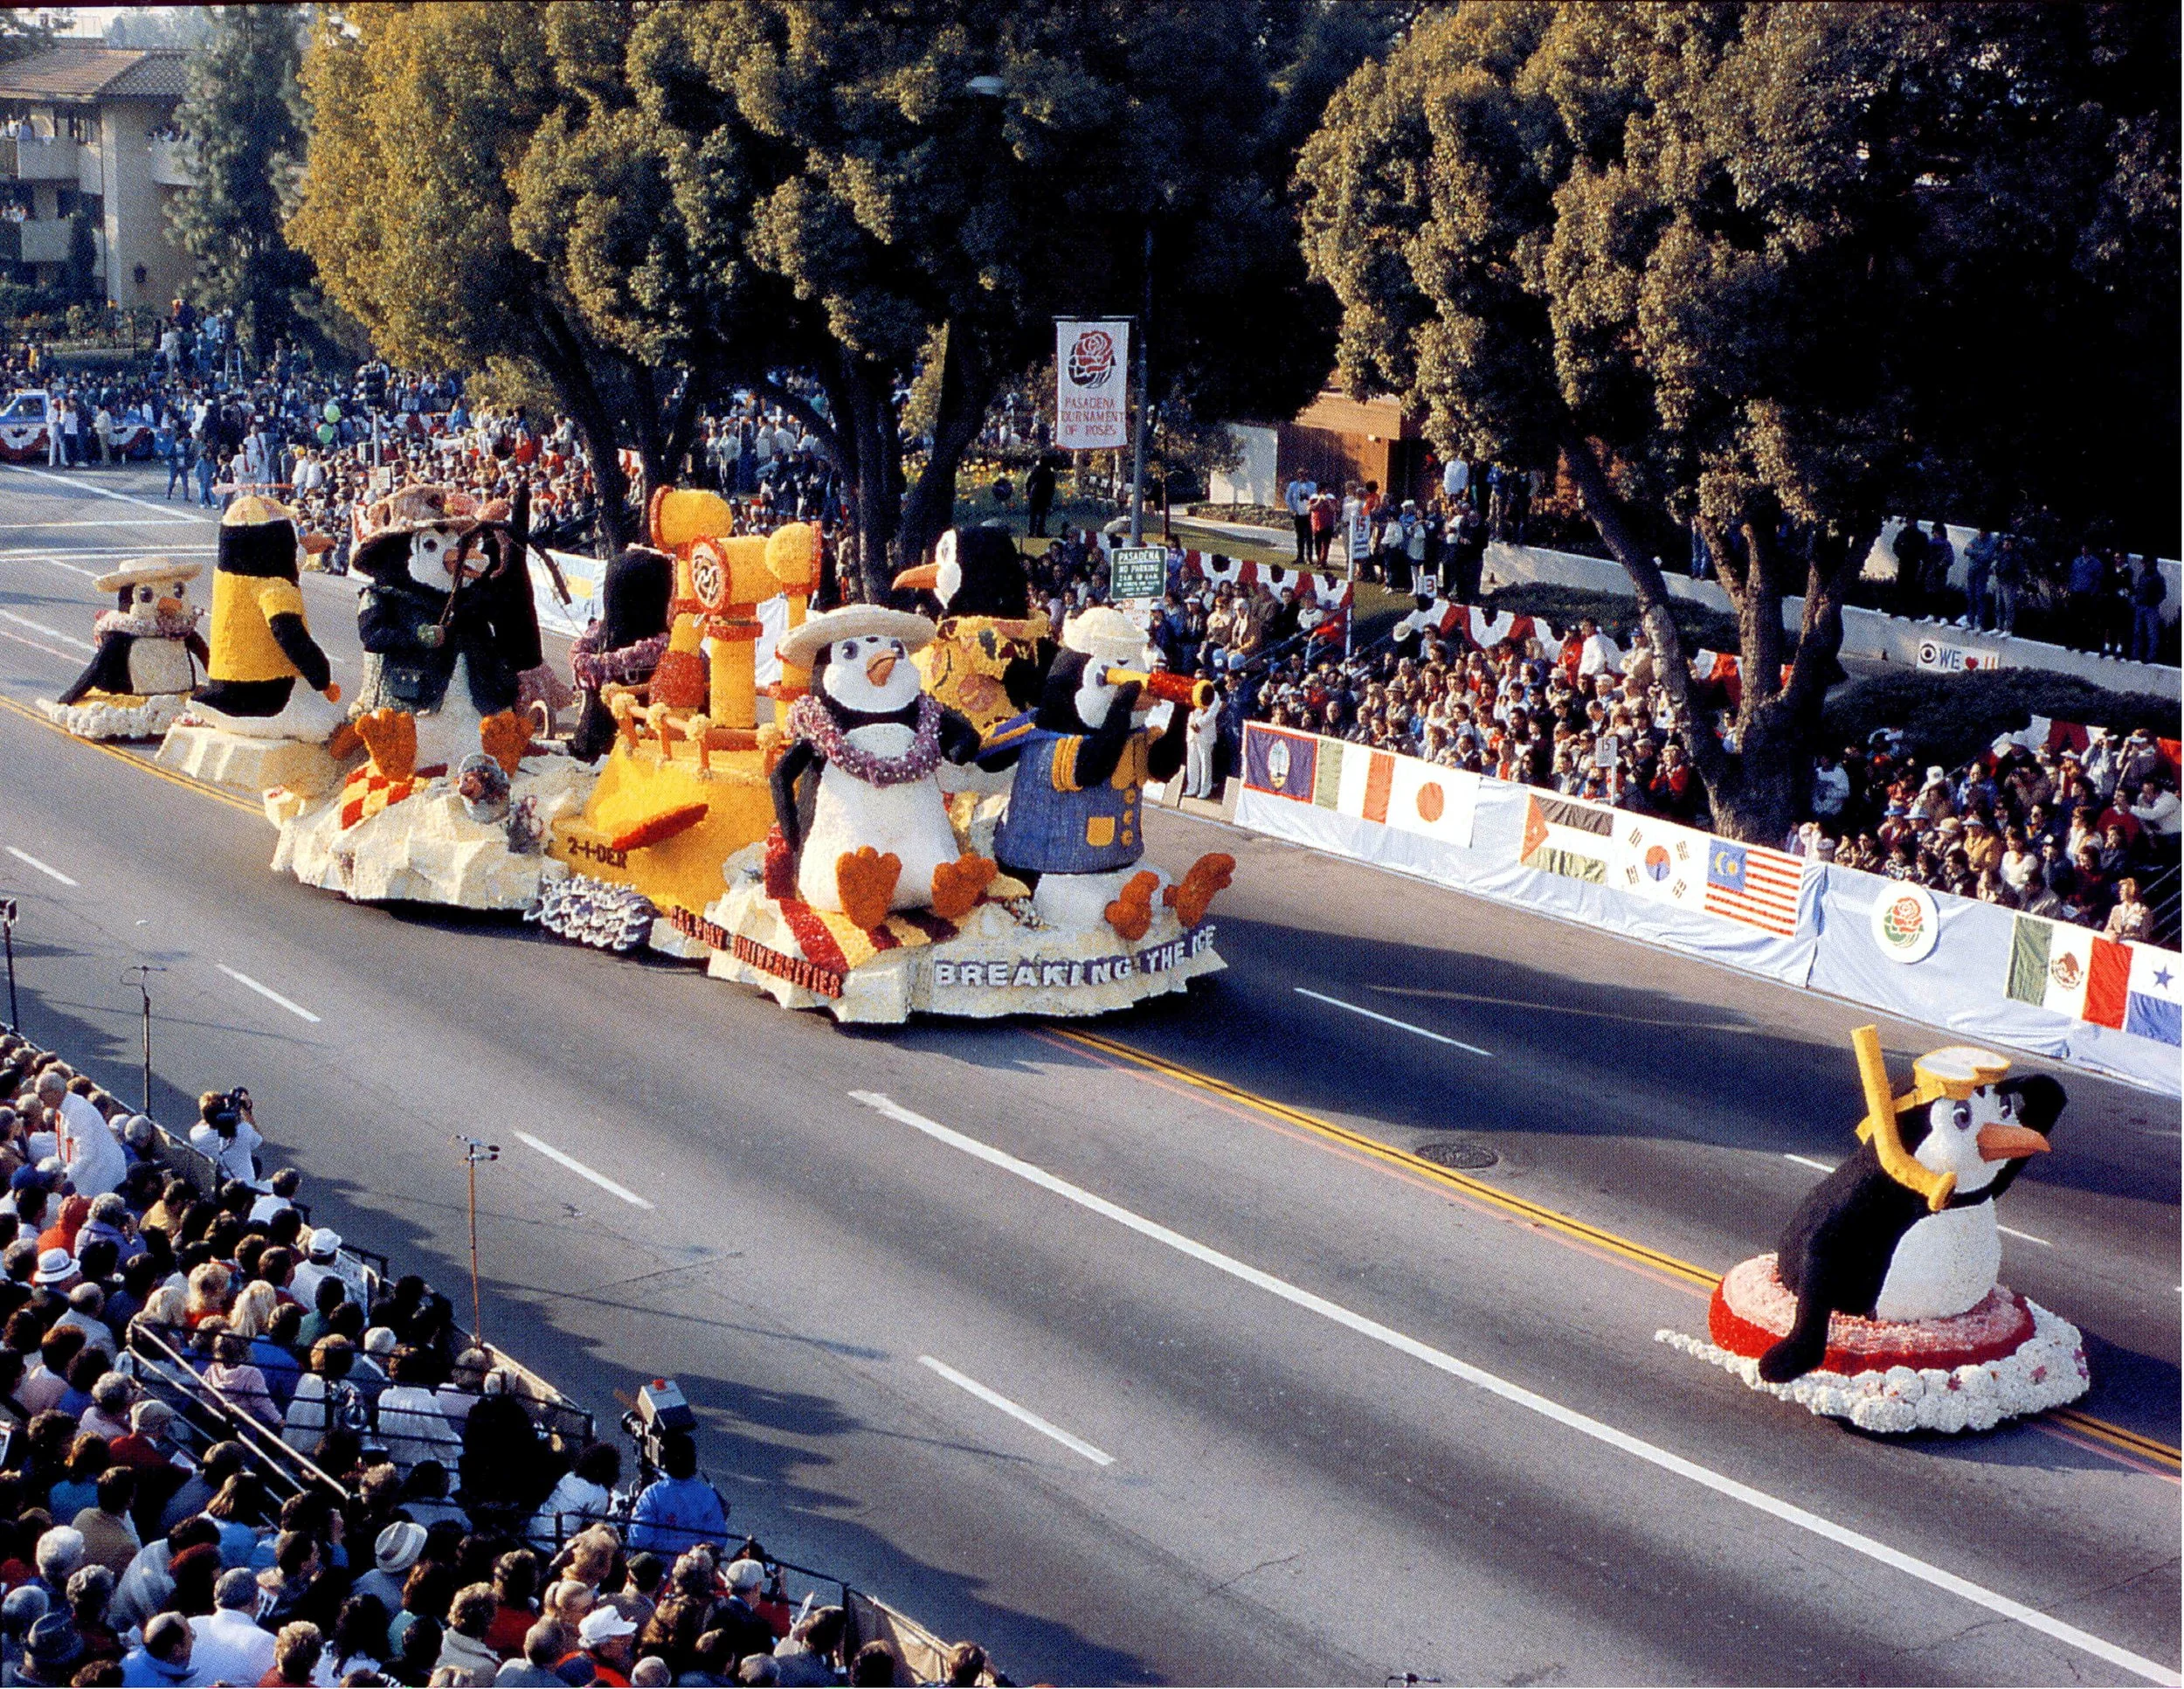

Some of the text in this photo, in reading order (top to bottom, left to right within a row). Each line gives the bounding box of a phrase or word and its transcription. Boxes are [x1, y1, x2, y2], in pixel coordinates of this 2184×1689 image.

[1065, 396, 1116, 409] PASADENA
[1065, 425, 1116, 436] OF ROSES
[1118, 550, 1160, 561] PASADENA
[1939, 647, 1961, 669] WE
[1601, 738, 1610, 752] 15
[670, 905, 844, 1000] CAL POLY UNIVERSITIES
[935, 924, 1217, 988] BREAKING THE ICE
